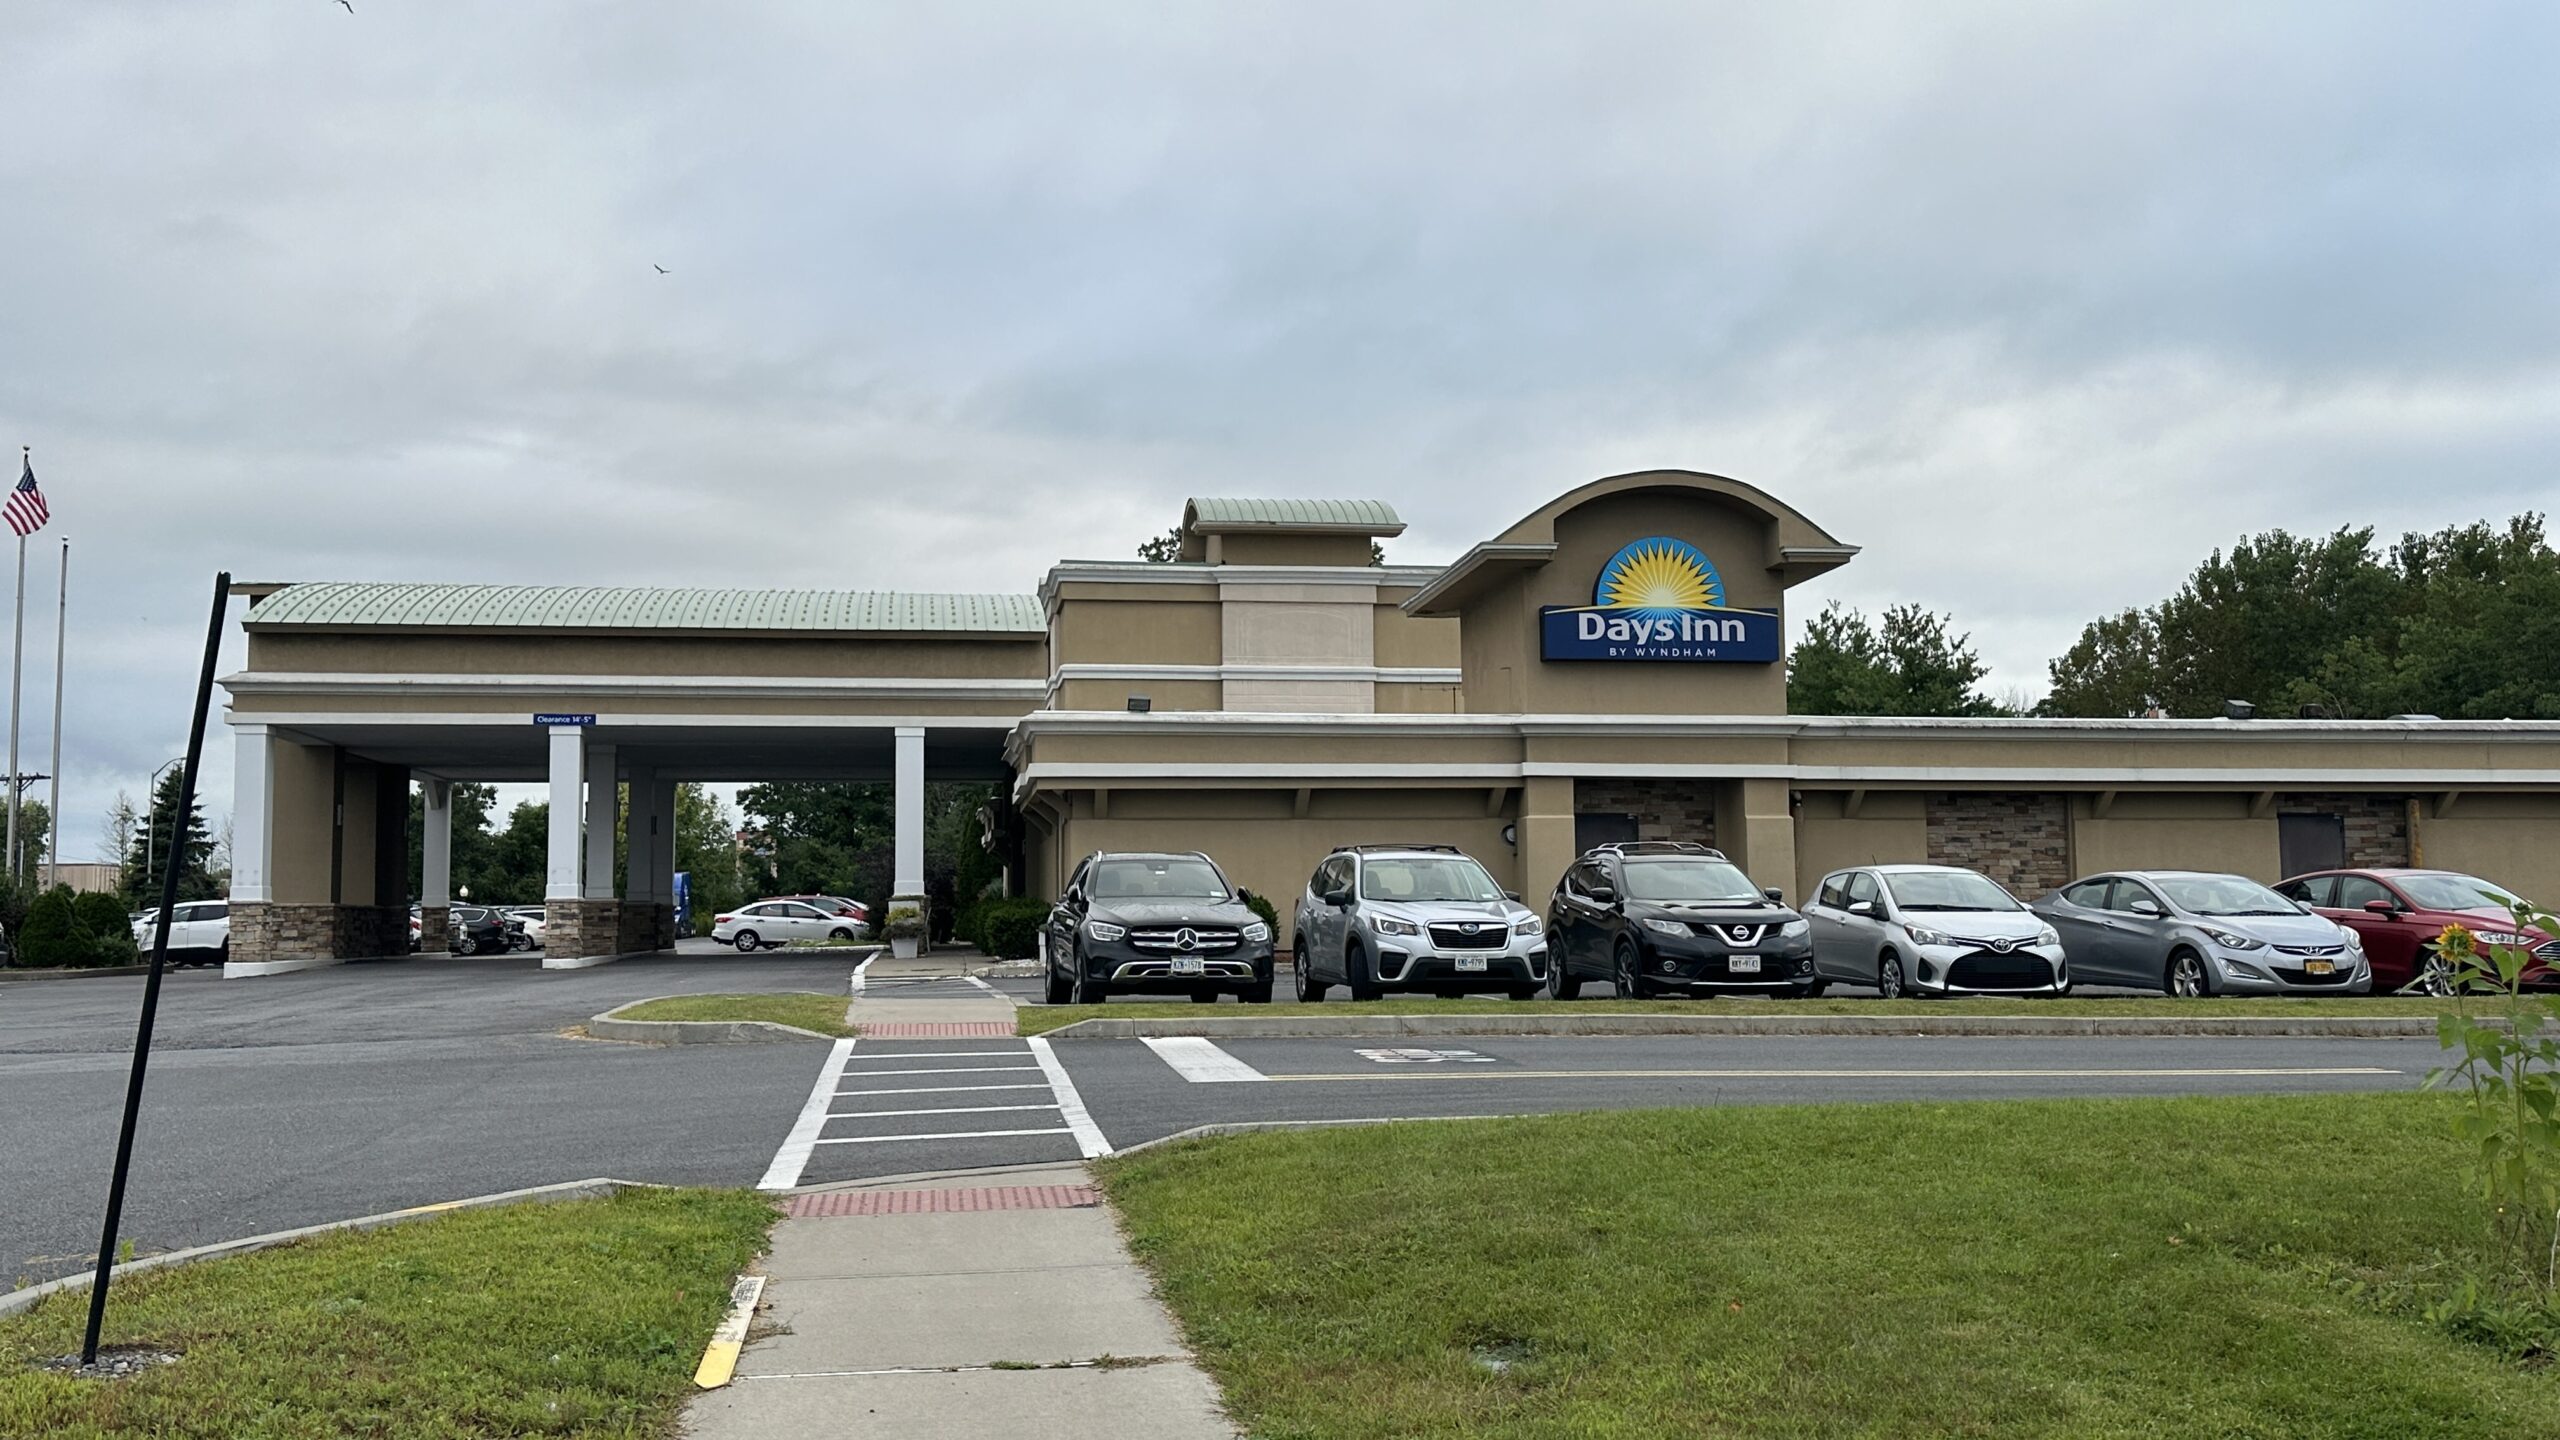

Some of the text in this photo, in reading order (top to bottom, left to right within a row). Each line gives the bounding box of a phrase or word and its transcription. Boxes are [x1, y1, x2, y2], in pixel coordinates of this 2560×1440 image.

[1578, 612, 1746, 645] Days Inn
[1609, 647, 1717, 657] BY WYNDHAM
[537, 715, 570, 723] Clearance
